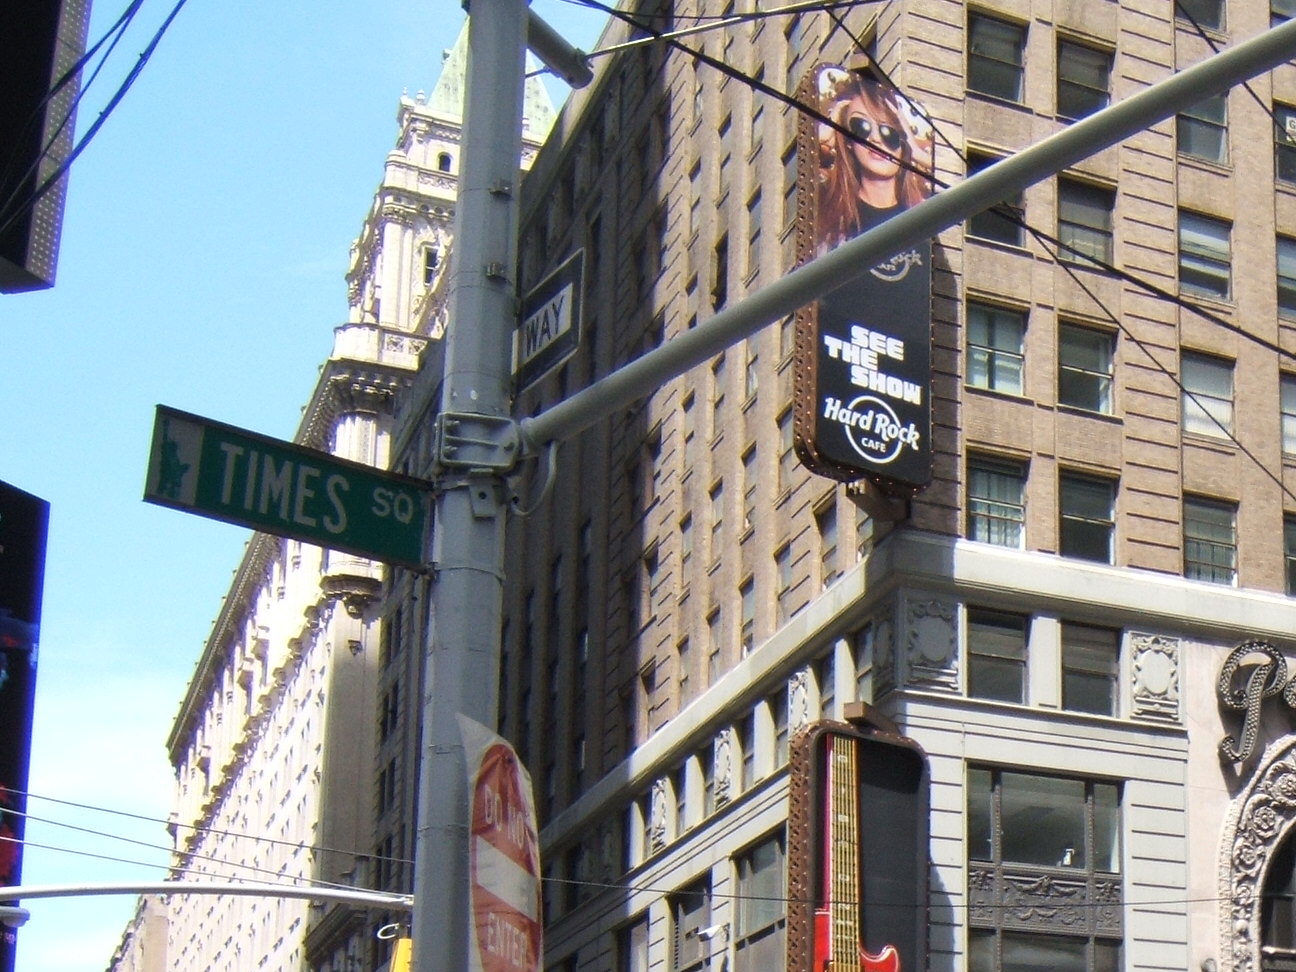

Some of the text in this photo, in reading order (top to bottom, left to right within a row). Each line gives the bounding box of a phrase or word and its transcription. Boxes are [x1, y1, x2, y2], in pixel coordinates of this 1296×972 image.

[525, 295, 565, 358] WAY
[823, 334, 878, 371] THE
[850, 324, 904, 361] SEE
[850, 364, 922, 405] SHOW
[824, 397, 920, 450] Hard Rock
[861, 437, 886, 453] CAFE
[219, 442, 414, 535] TIMES SQ
[484, 783, 526, 850] DO NO
[487, 911, 529, 969] ENTER
